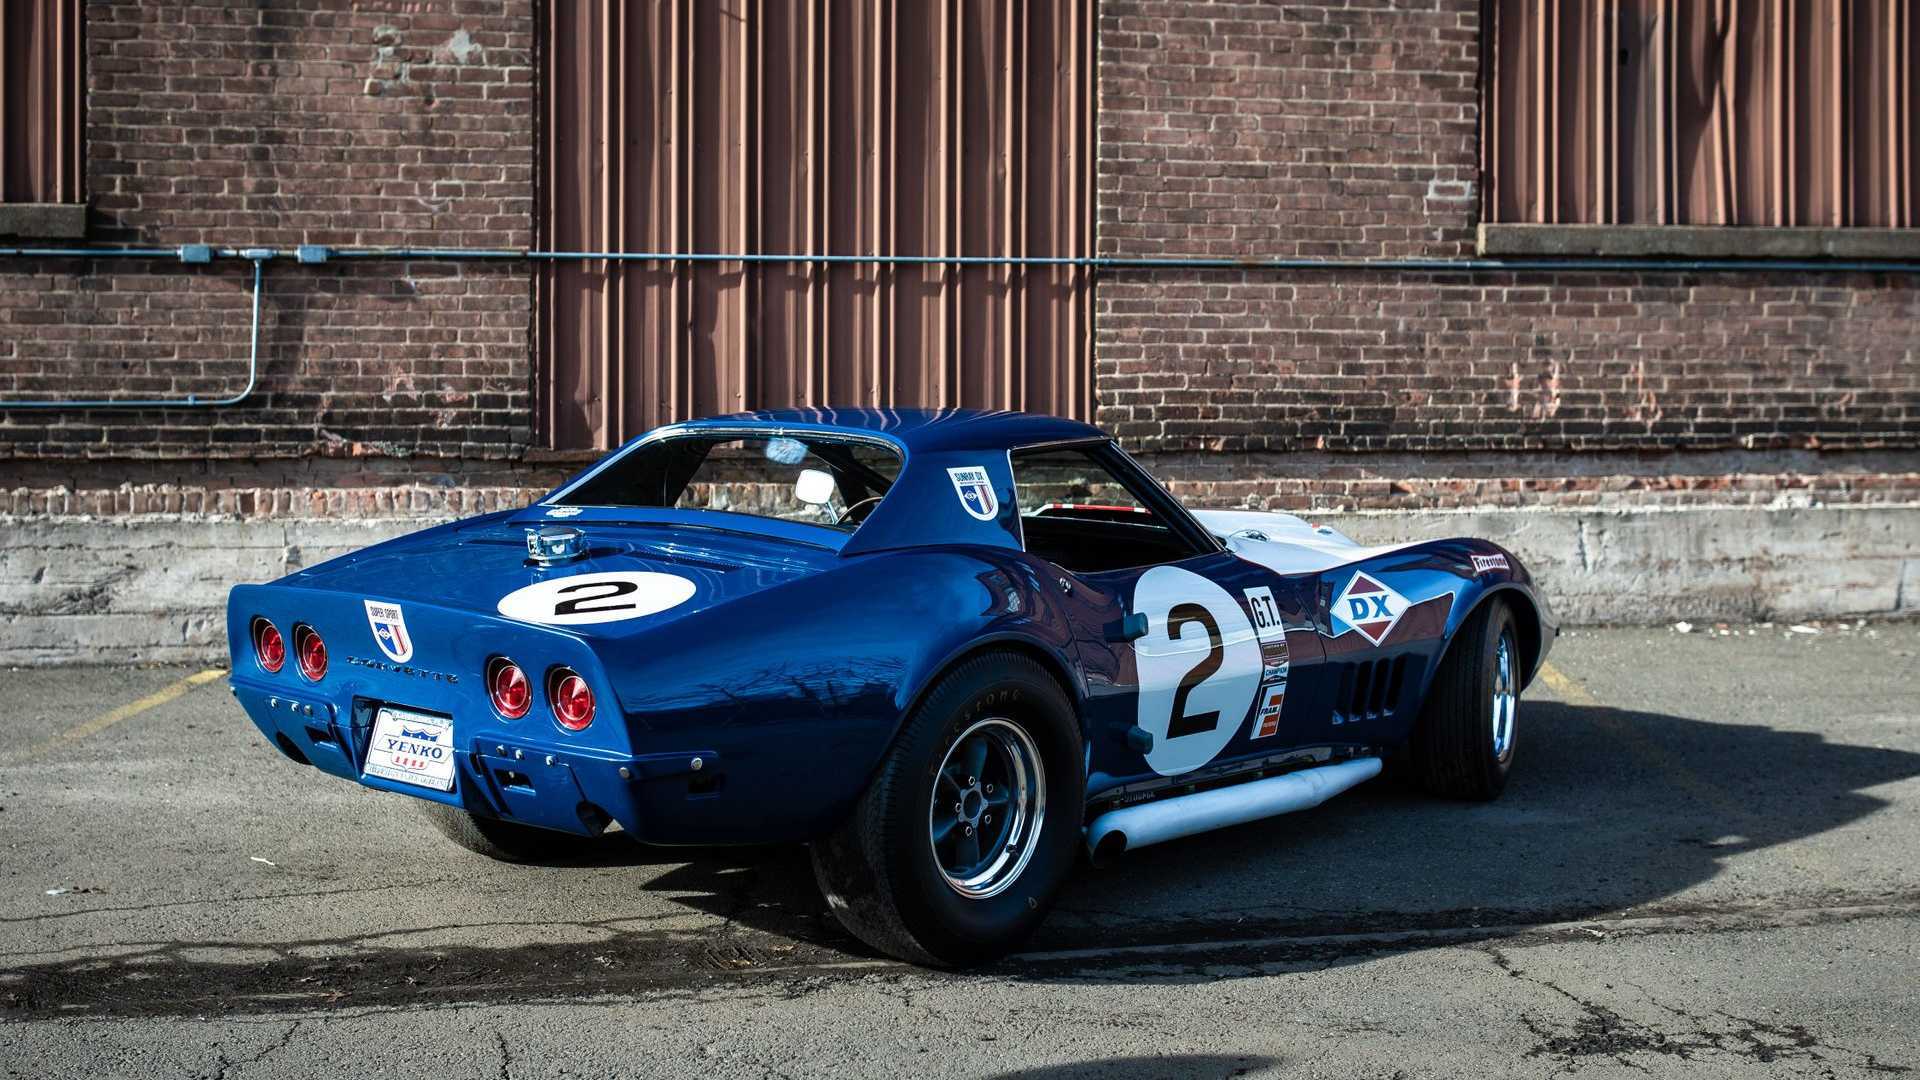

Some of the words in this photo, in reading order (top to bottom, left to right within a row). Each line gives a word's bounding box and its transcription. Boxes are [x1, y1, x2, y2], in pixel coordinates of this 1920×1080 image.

[1473, 557, 1507, 568] Firestone
[554, 581, 638, 616] 2
[1251, 596, 1280, 628] G.T.
[1346, 594, 1394, 620] DX
[346, 656, 459, 684] CORVETTE
[1166, 603, 1224, 739] 2
[388, 739, 443, 759] YENKO
